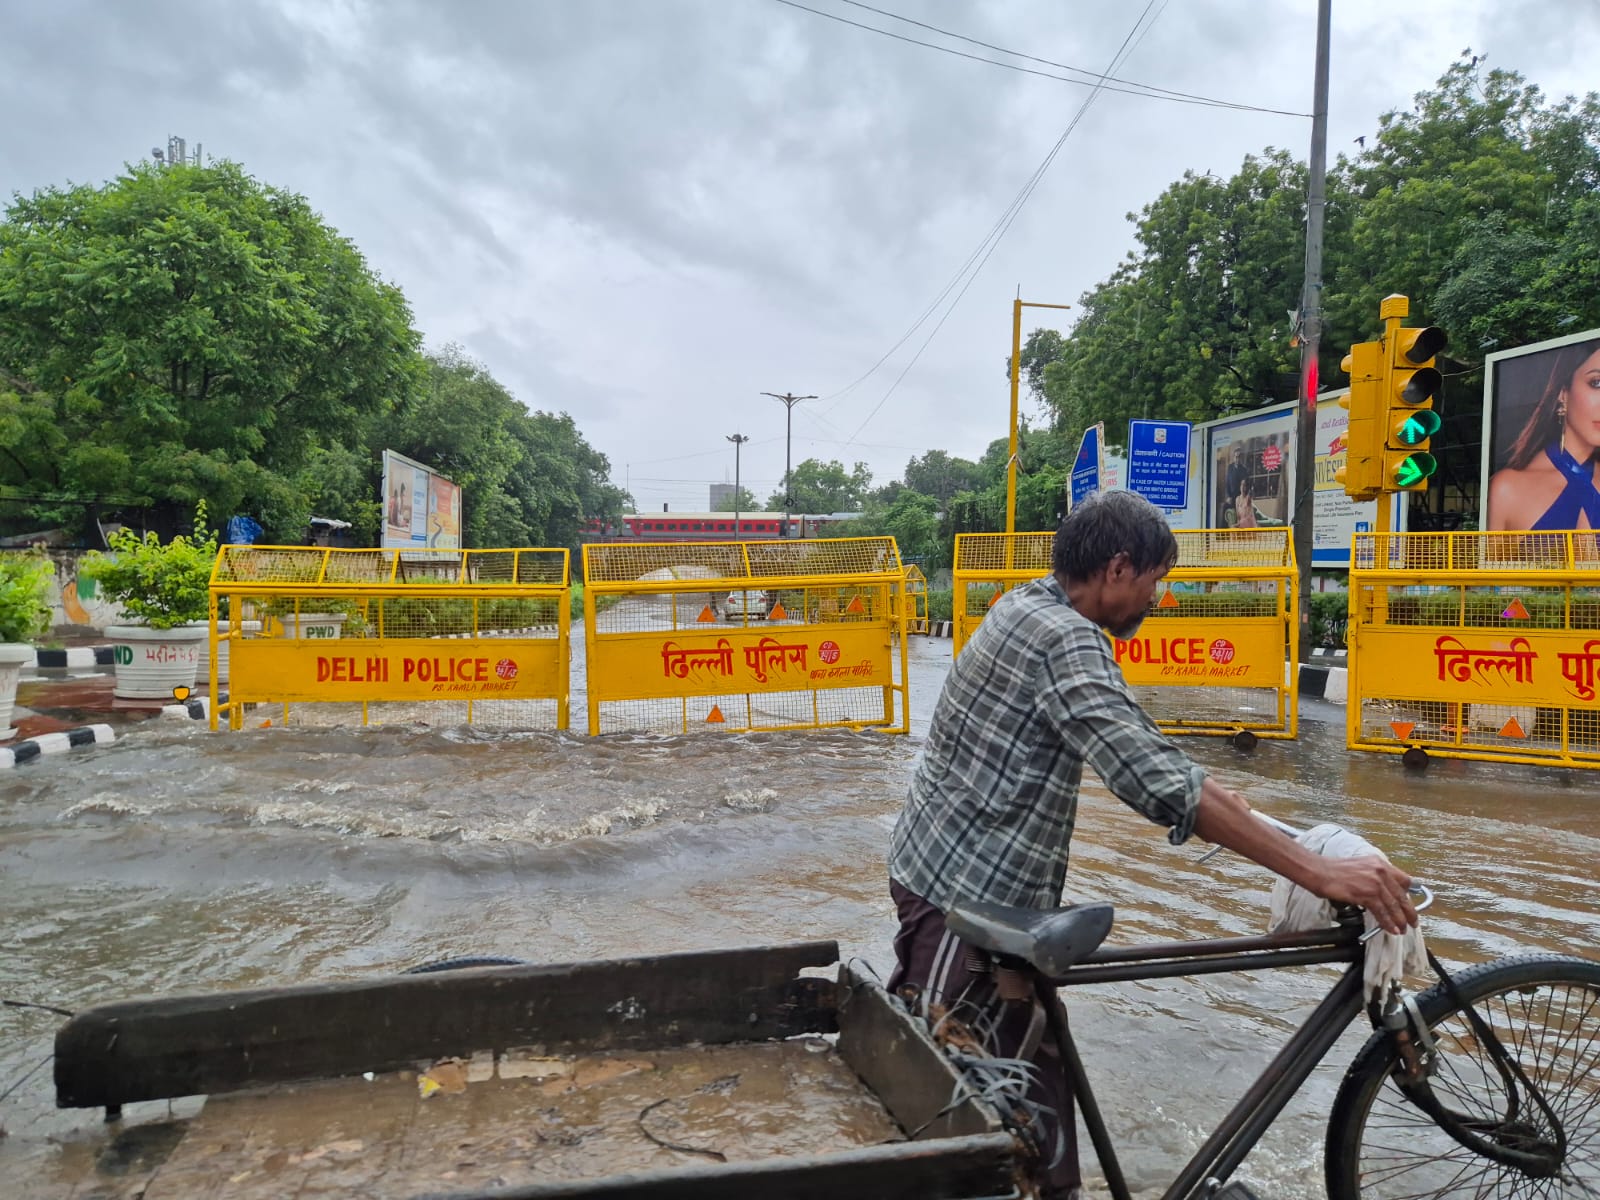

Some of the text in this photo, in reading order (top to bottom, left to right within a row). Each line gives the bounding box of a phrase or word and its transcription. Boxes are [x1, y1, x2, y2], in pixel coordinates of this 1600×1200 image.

[306, 626, 335, 639] PWD
[661, 638, 808, 683] दिल्ली पुलिस
[1114, 638, 1205, 664] POLICE
[1433, 636, 1539, 686] दिल्ली
[317, 656, 489, 682] DELHI POLICE
[1175, 666, 1207, 676] KAMLA
[1209, 665, 1250, 677] MARKET
[447, 683, 476, 692] KAMLA
[481, 681, 518, 692] MARKET
